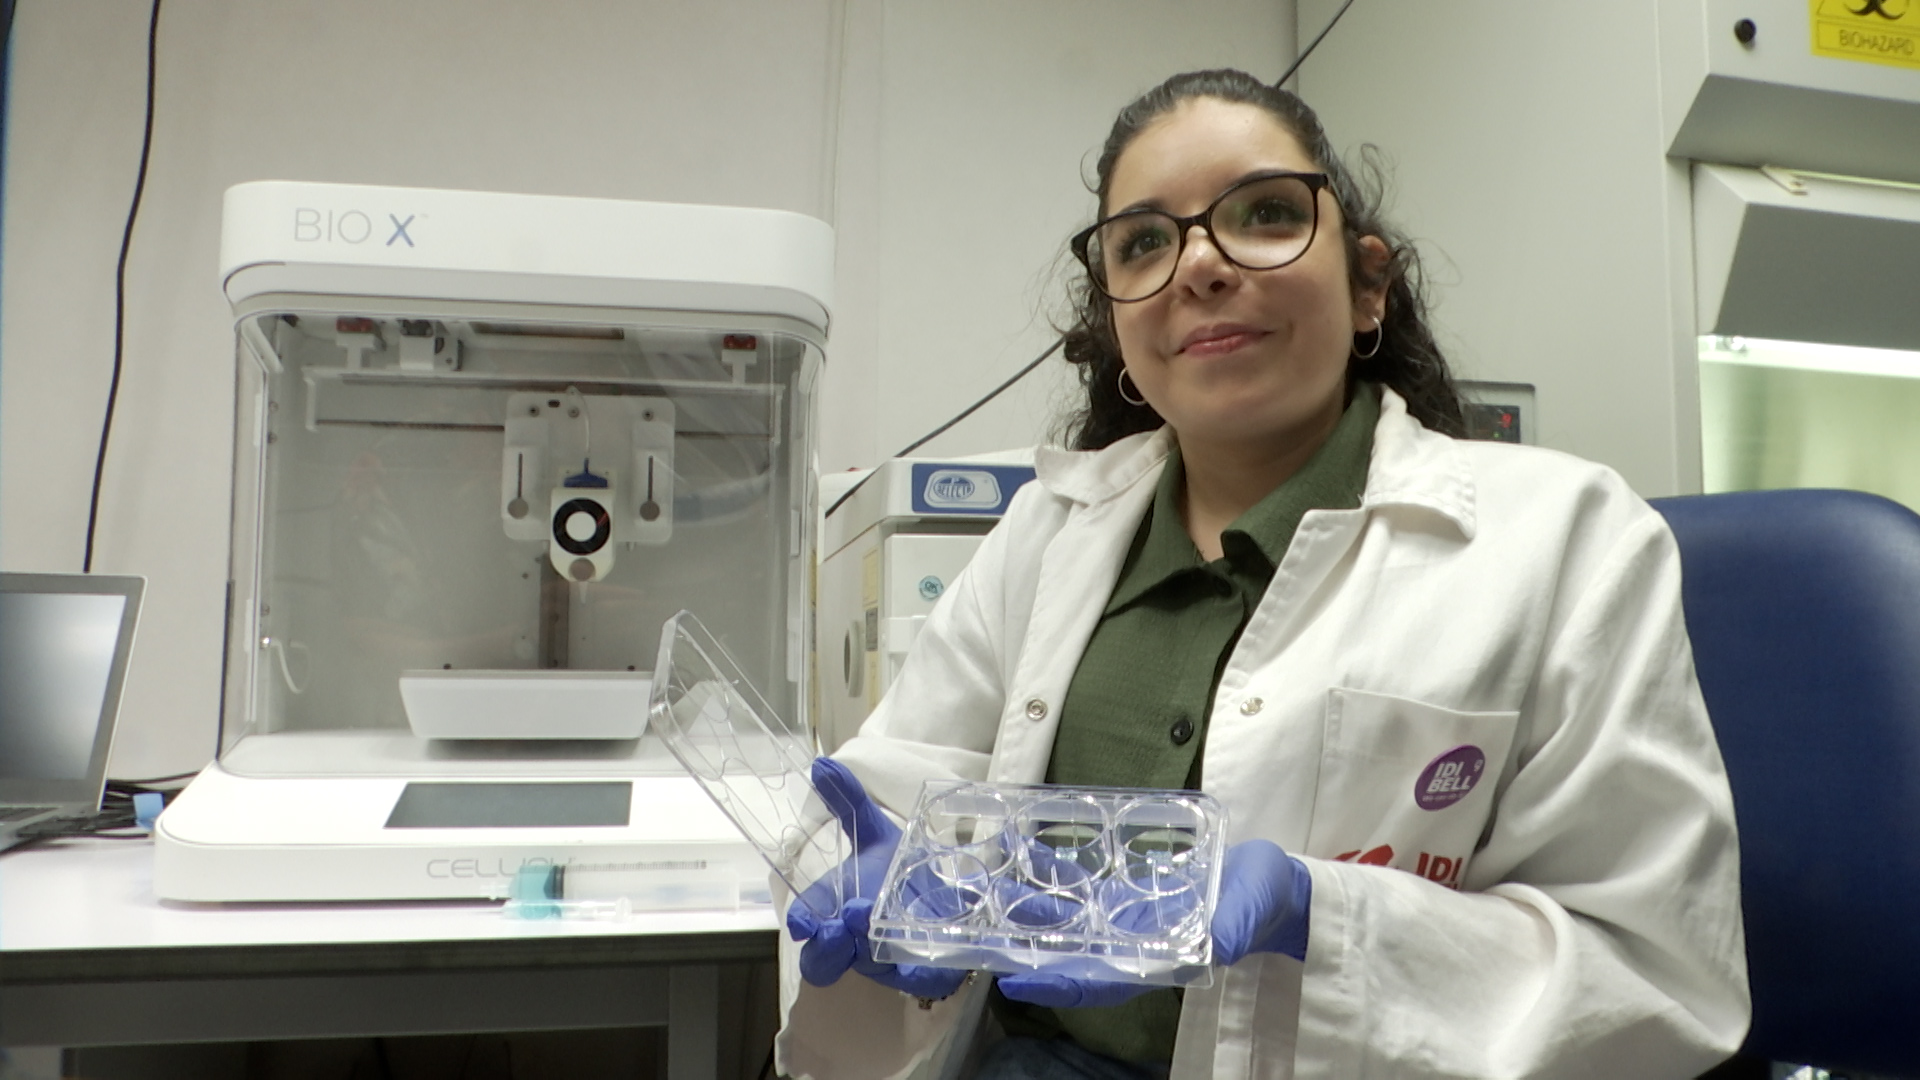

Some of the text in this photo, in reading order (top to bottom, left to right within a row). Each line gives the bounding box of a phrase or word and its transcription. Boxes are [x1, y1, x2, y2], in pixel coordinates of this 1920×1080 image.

[1839, 29, 1915, 56] BIOHAZARD
[294, 207, 372, 244] BIO
[1434, 761, 1465, 778] IDI
[1425, 775, 1472, 794] BELL
[1416, 851, 1463, 882] IDI
